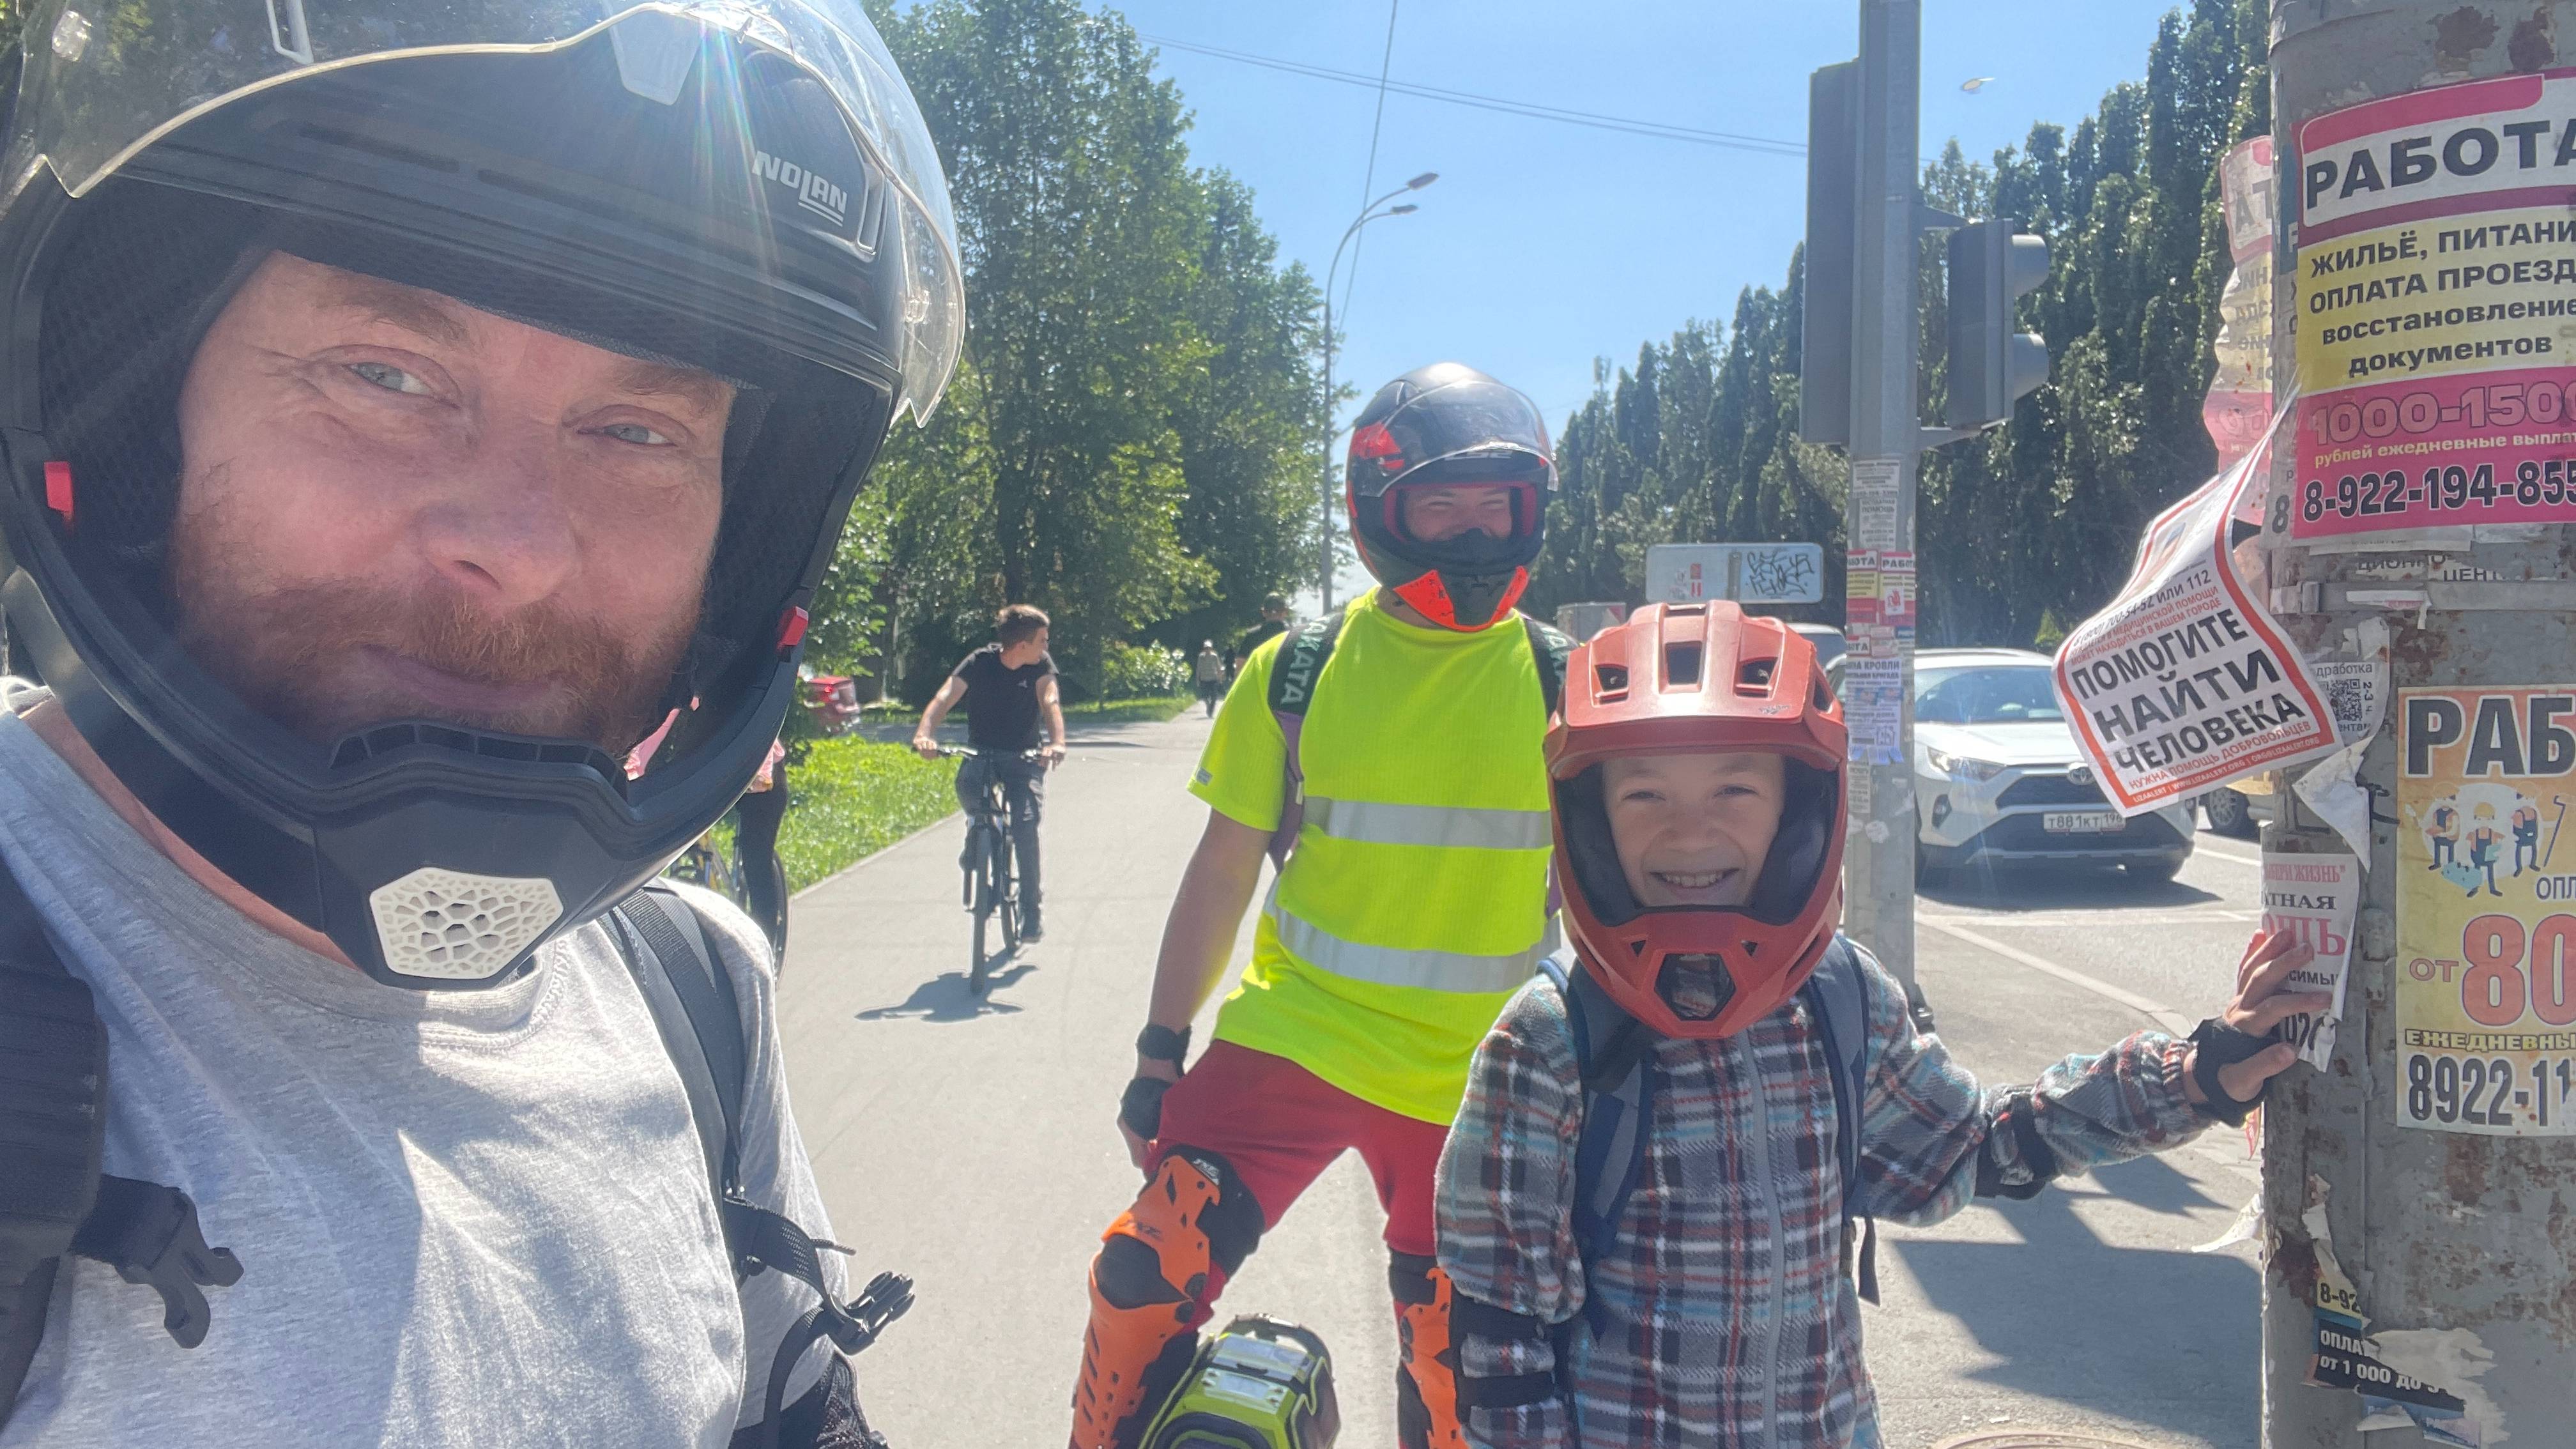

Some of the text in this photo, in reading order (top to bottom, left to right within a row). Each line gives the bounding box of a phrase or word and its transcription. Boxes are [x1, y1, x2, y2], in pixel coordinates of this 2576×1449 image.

[752, 151, 848, 222] NOLAN
[2310, 230, 2428, 279] ЖИЛЬЁ,
[2438, 220, 2576, 254] ПИТАНИ
[2310, 273, 2428, 314] ОПЛАТА
[2438, 258, 2576, 291] ПРОЕЗД
[2322, 298, 2576, 346] восстановление
[2349, 336, 2553, 378] документов
[2315, 442, 2373, 468] рублей
[2378, 435, 2508, 458] ежедневные
[2113, 604, 2177, 635] МЕДИЦИНСКОЙ
[2177, 586, 2219, 607] ПОМОЩИ
[2156, 583, 2184, 604] ИЛИ
[2186, 569, 2212, 590] 112
[2155, 613, 2186, 631] ВАШЕМ
[2186, 597, 2222, 620] ГОРОДЕ
[2071, 608, 2249, 701] ПОМОГИТЕ
[2316, 663, 2373, 678] дработка
[2092, 648, 2281, 744] НАЙТИ
[2114, 692, 2306, 775] ЧЕЛОВЕКА
[2129, 721, 2312, 790] НУЖНА ПОМОЩЬ ДОБРОВОЛЬЦЕВ
[2407, 696, 2576, 776] РАБ
[2320, 1330, 2365, 1356] ОПЛА
[2342, 1360, 2350, 1375] 1
[2356, 1363, 2391, 1384] 000
